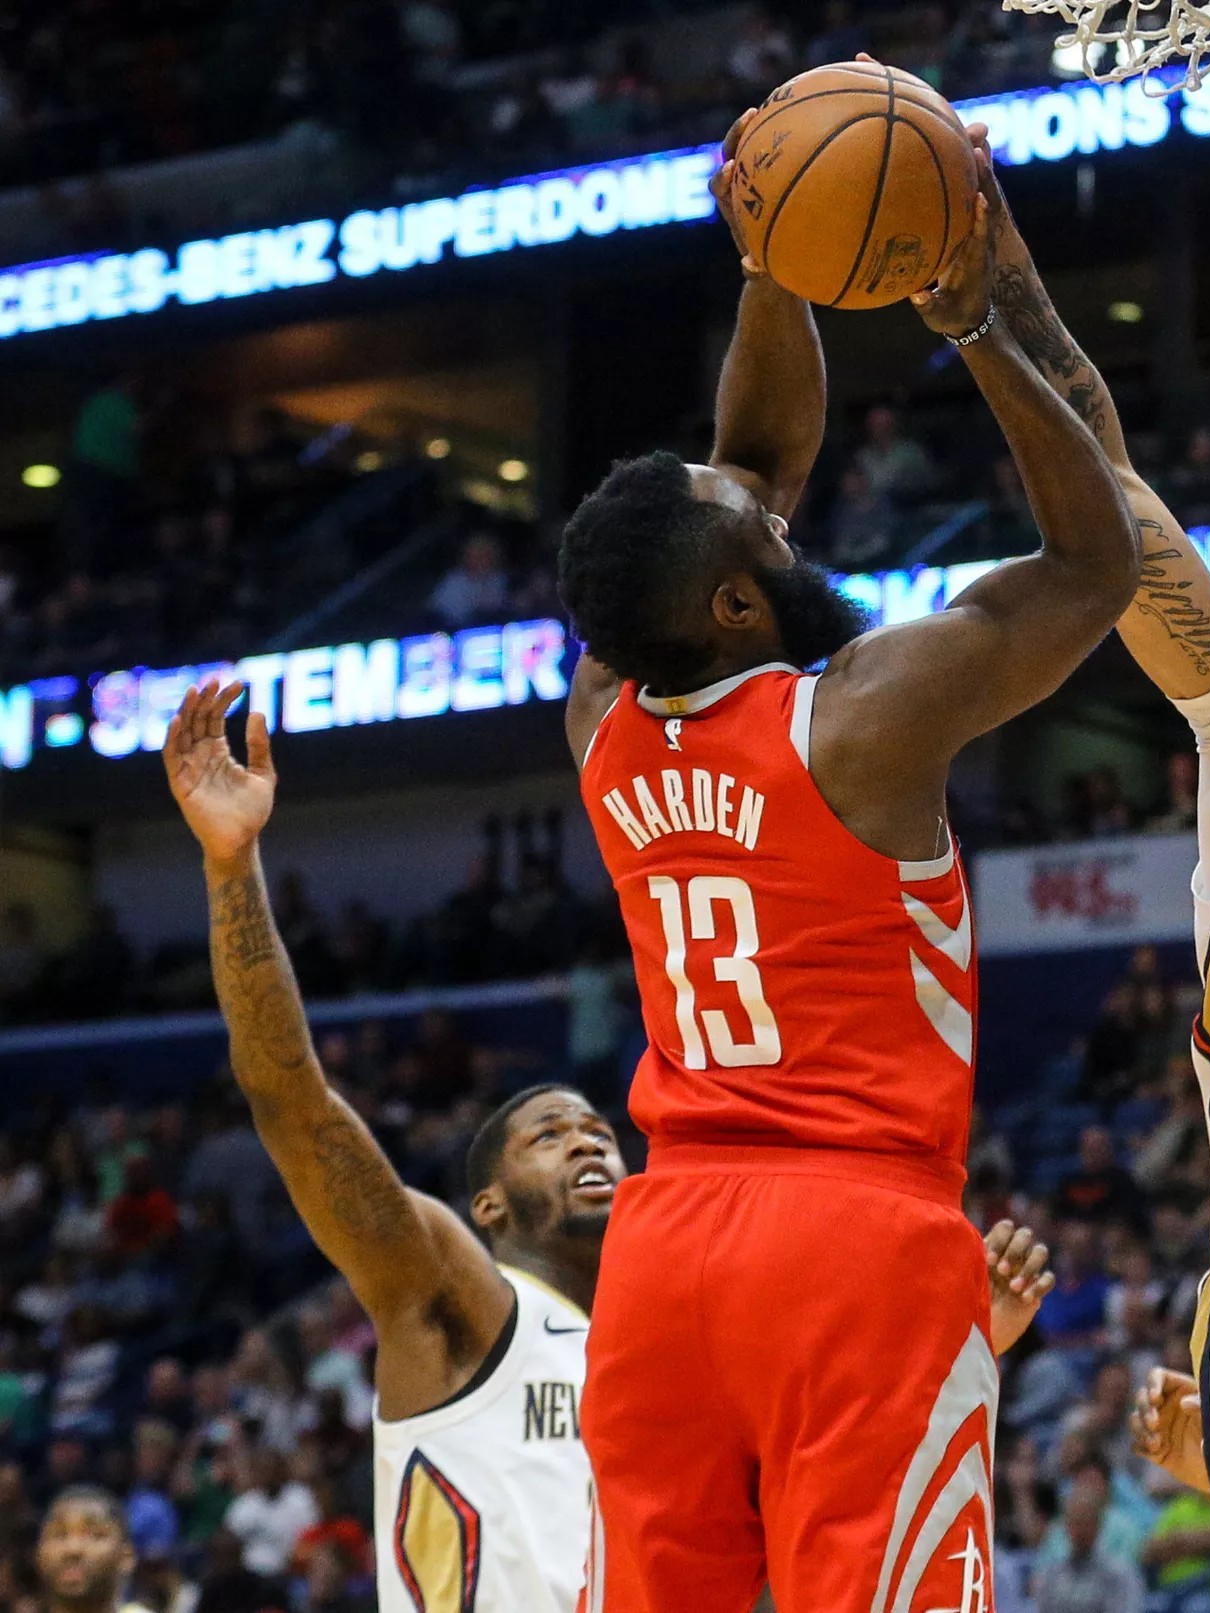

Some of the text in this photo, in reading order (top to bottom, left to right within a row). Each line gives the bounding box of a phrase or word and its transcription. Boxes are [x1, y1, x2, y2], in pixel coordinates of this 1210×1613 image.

[338, 153, 717, 277] SUPERDOME
[960, 331, 979, 346] BIG
[602, 768, 765, 852] HARDEN
[648, 875, 782, 1071] 13
